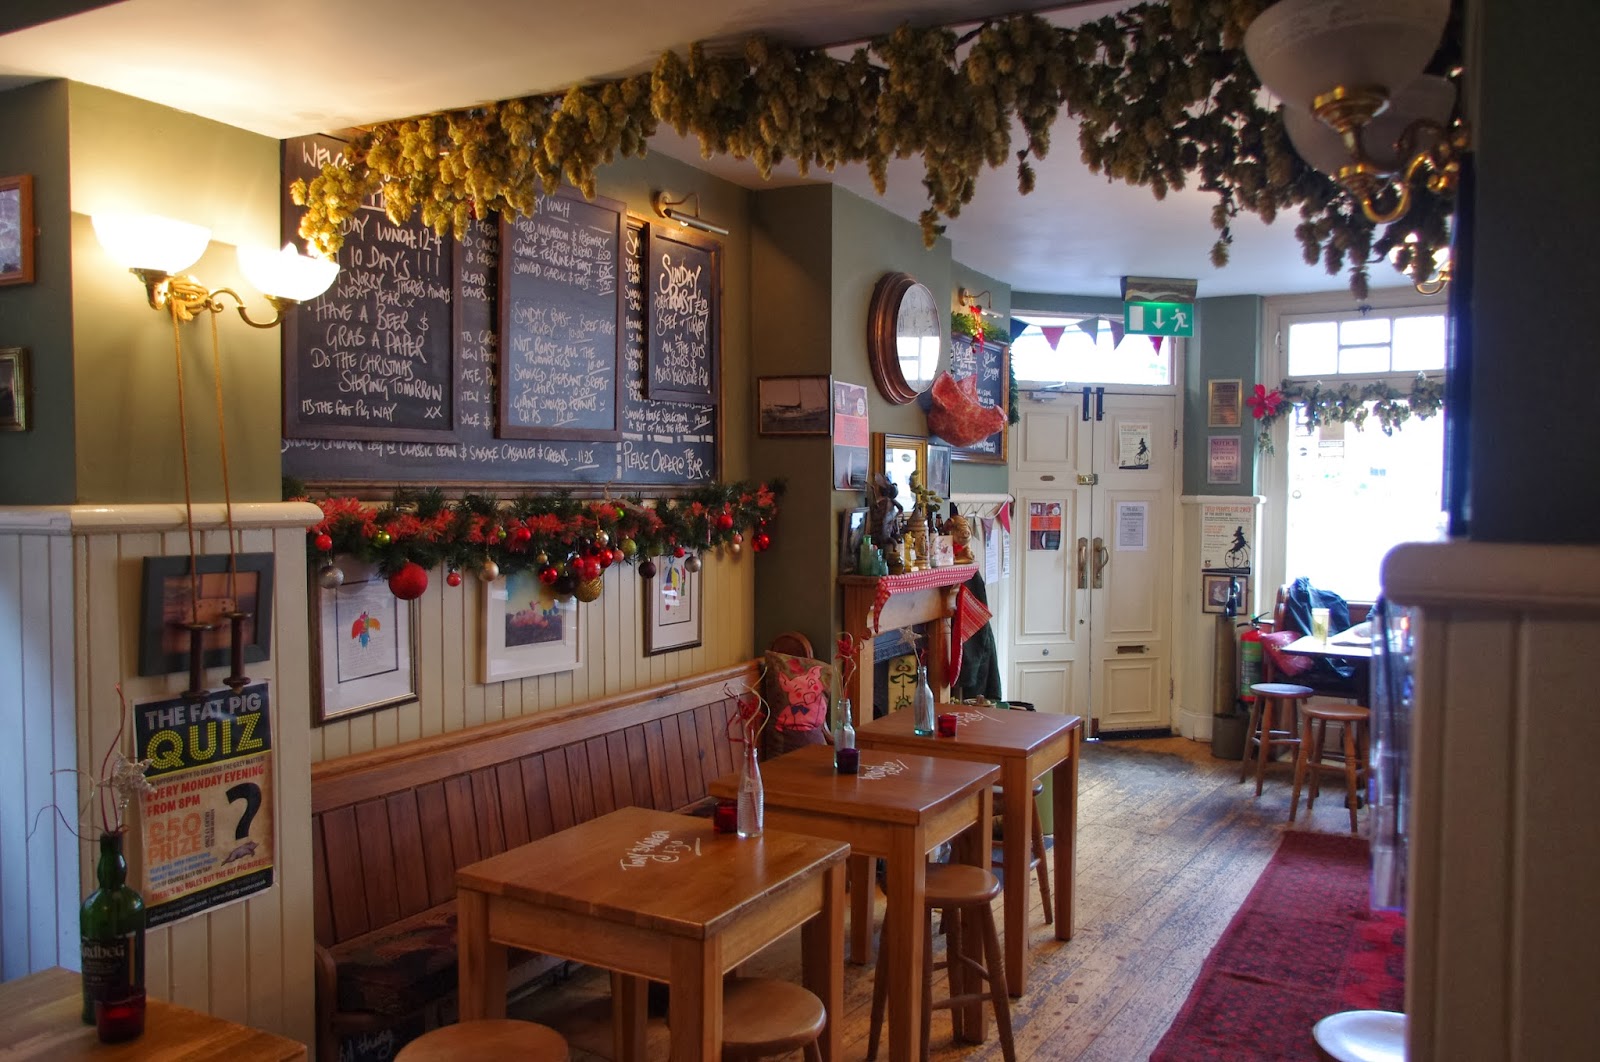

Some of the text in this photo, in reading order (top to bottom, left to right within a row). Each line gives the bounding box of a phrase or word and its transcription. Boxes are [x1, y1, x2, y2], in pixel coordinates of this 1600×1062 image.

[659, 254, 702, 298] SUNDAY
[337, 284, 371, 300] NEXT
[315, 294, 352, 322] HAVE
[358, 306, 369, 323] A
[376, 303, 411, 335] BEER
[515, 301, 547, 324] SUNDAY
[326, 323, 427, 363] GRAB A PAPER
[580, 346, 595, 359] THE
[311, 348, 414, 381] DO THE CHRISTMAS
[315, 400, 333, 415] THE
[373, 403, 398, 422] WAY
[628, 421, 634, 430] A
[623, 441, 650, 472] PLEASE
[683, 448, 694, 459] THE
[687, 457, 703, 479] BAR
[145, 692, 262, 730] THE FAT PIG
[147, 712, 263, 770] QUIZ
[147, 765, 264, 802] EVERY MONDAY EVENING
[147, 800, 177, 817] FROM
[179, 794, 200, 809] 8PM
[148, 812, 201, 846] £50
[148, 834, 200, 865] PRIZE
